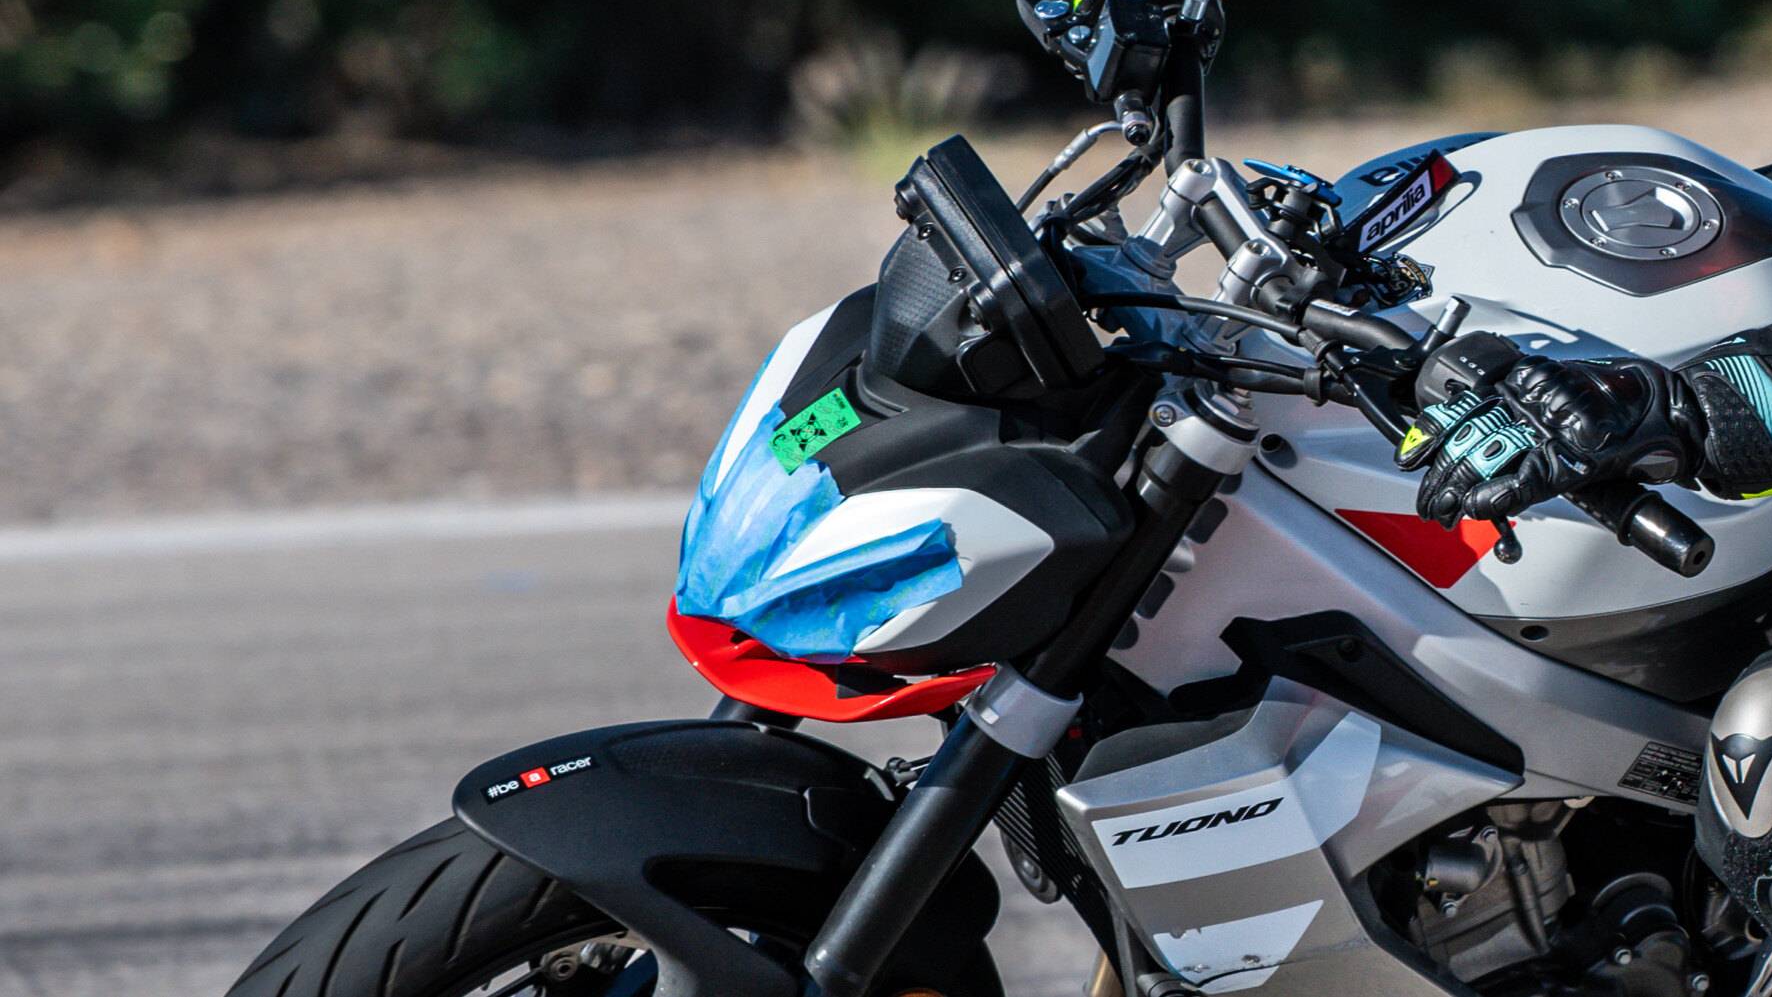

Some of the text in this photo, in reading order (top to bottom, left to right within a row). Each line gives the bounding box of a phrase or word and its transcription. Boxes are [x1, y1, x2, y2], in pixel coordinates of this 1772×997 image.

[1366, 183, 1426, 242] aprilia
[487, 756, 592, 798] #be a racer
[1111, 797, 1285, 847] TUONO
